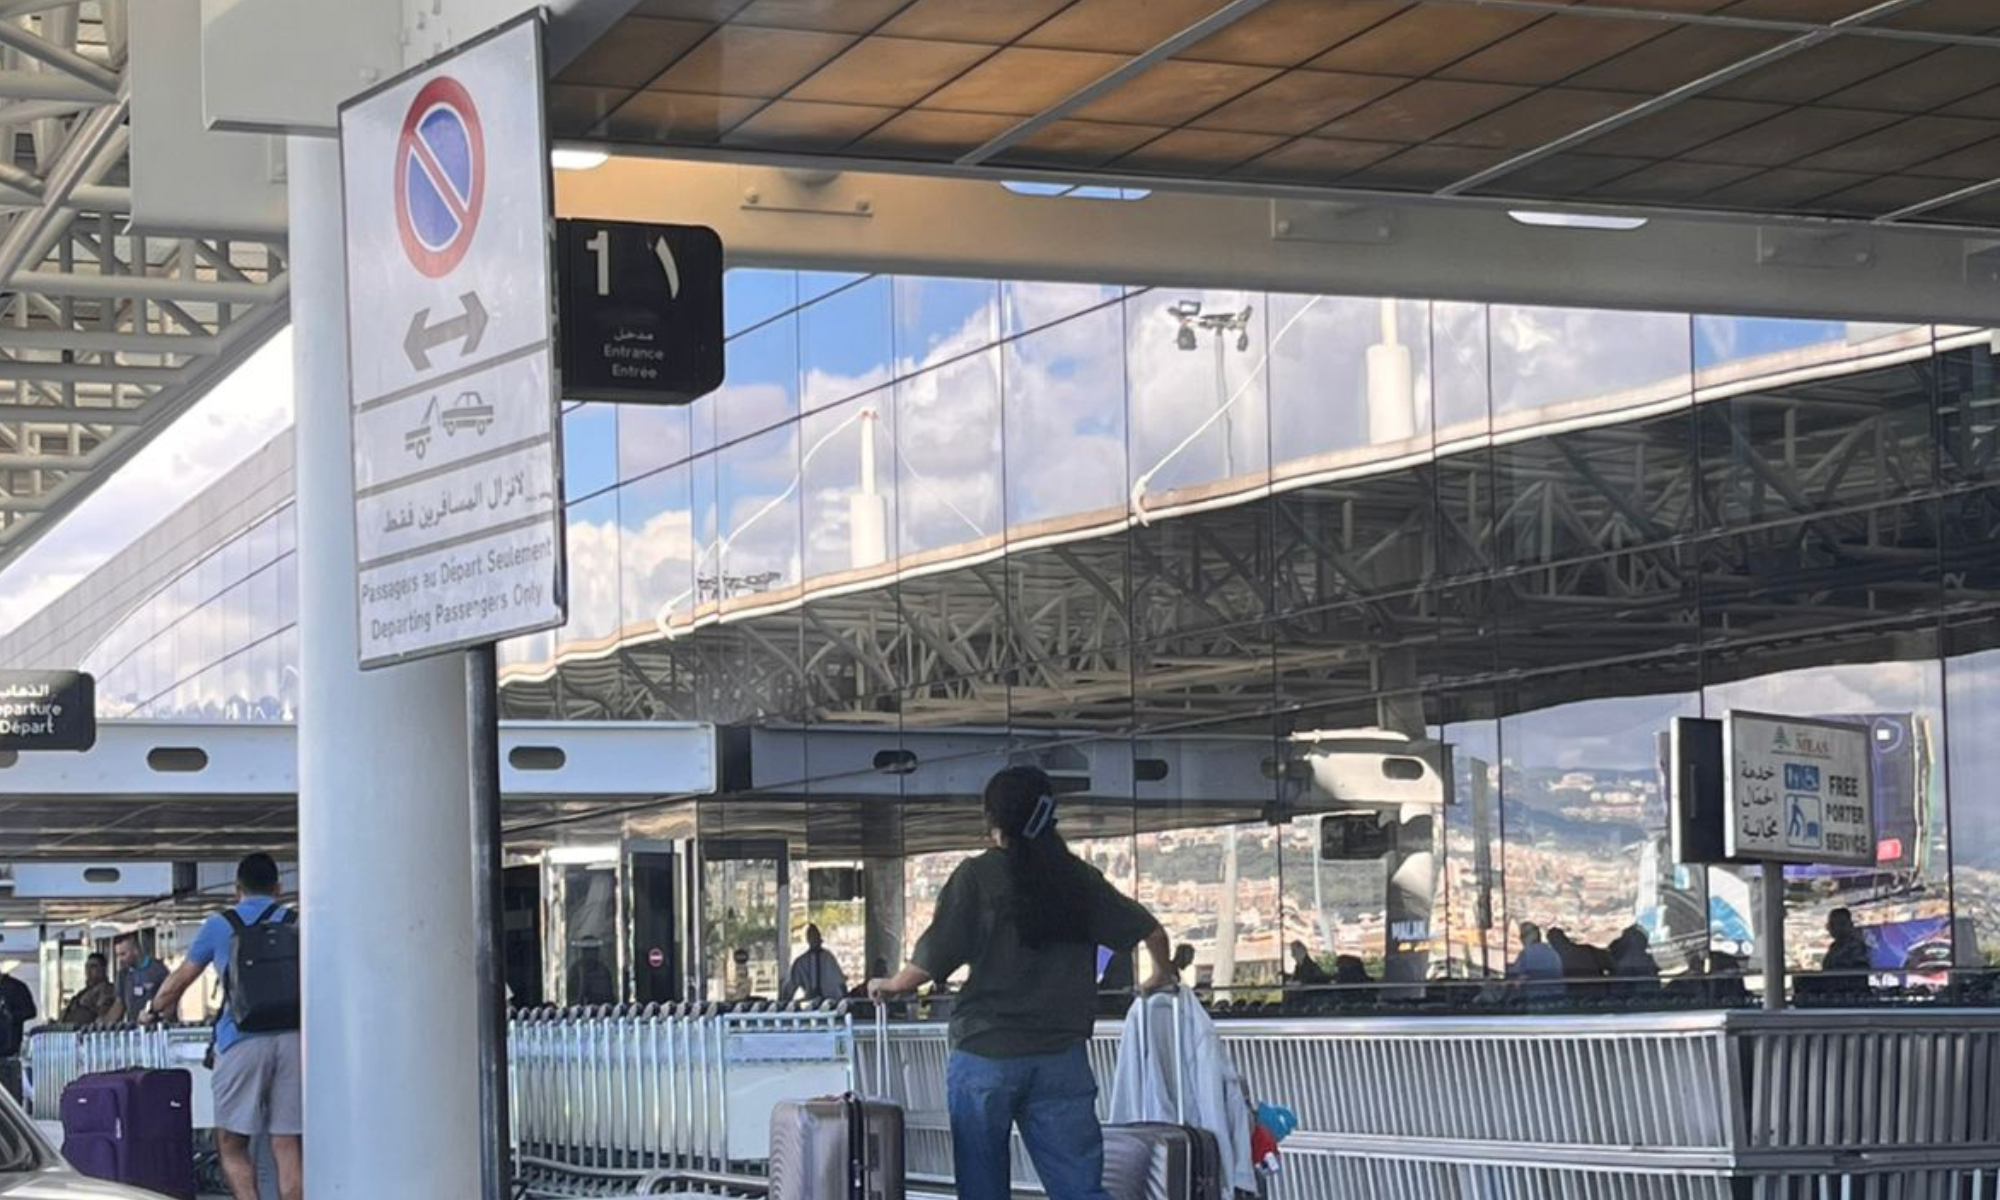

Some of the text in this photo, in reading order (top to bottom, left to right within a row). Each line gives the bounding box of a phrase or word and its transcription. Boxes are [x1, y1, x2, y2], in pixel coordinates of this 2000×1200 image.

[586, 230, 609, 296] 1
[603, 344, 664, 360] Entrance
[383, 502, 414, 533] فقط
[361, 536, 552, 604] Passagers au Départ Seulement
[371, 581, 544, 641] Departing Passengers Only
[1828, 775, 1859, 798] FREE
[1825, 803, 1865, 824] PORTER
[1825, 833, 1868, 854] SERVICE
